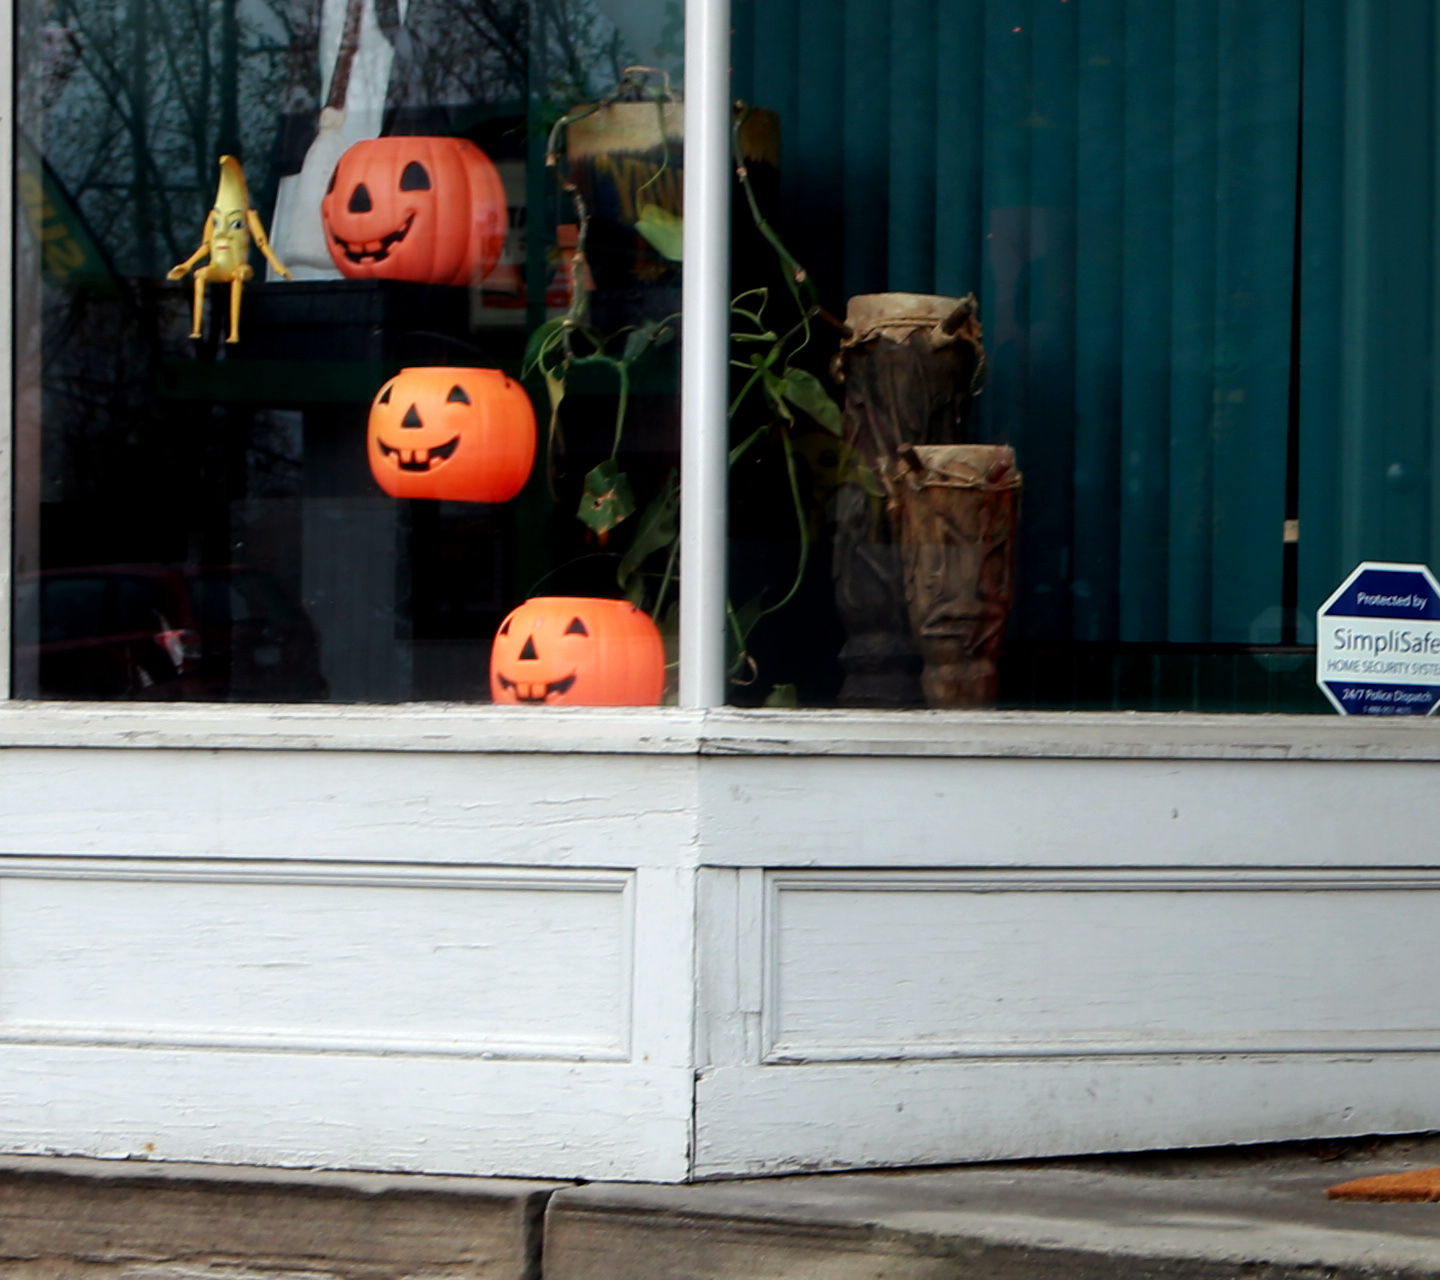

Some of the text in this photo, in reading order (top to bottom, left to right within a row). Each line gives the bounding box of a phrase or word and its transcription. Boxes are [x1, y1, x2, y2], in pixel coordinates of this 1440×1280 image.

[1357, 591, 1428, 611] Protected by
[1327, 659, 1362, 673] HOME
[1361, 660, 1411, 675] SECURITY
[1341, 688, 1433, 705] 24/7 Police Dispatch
